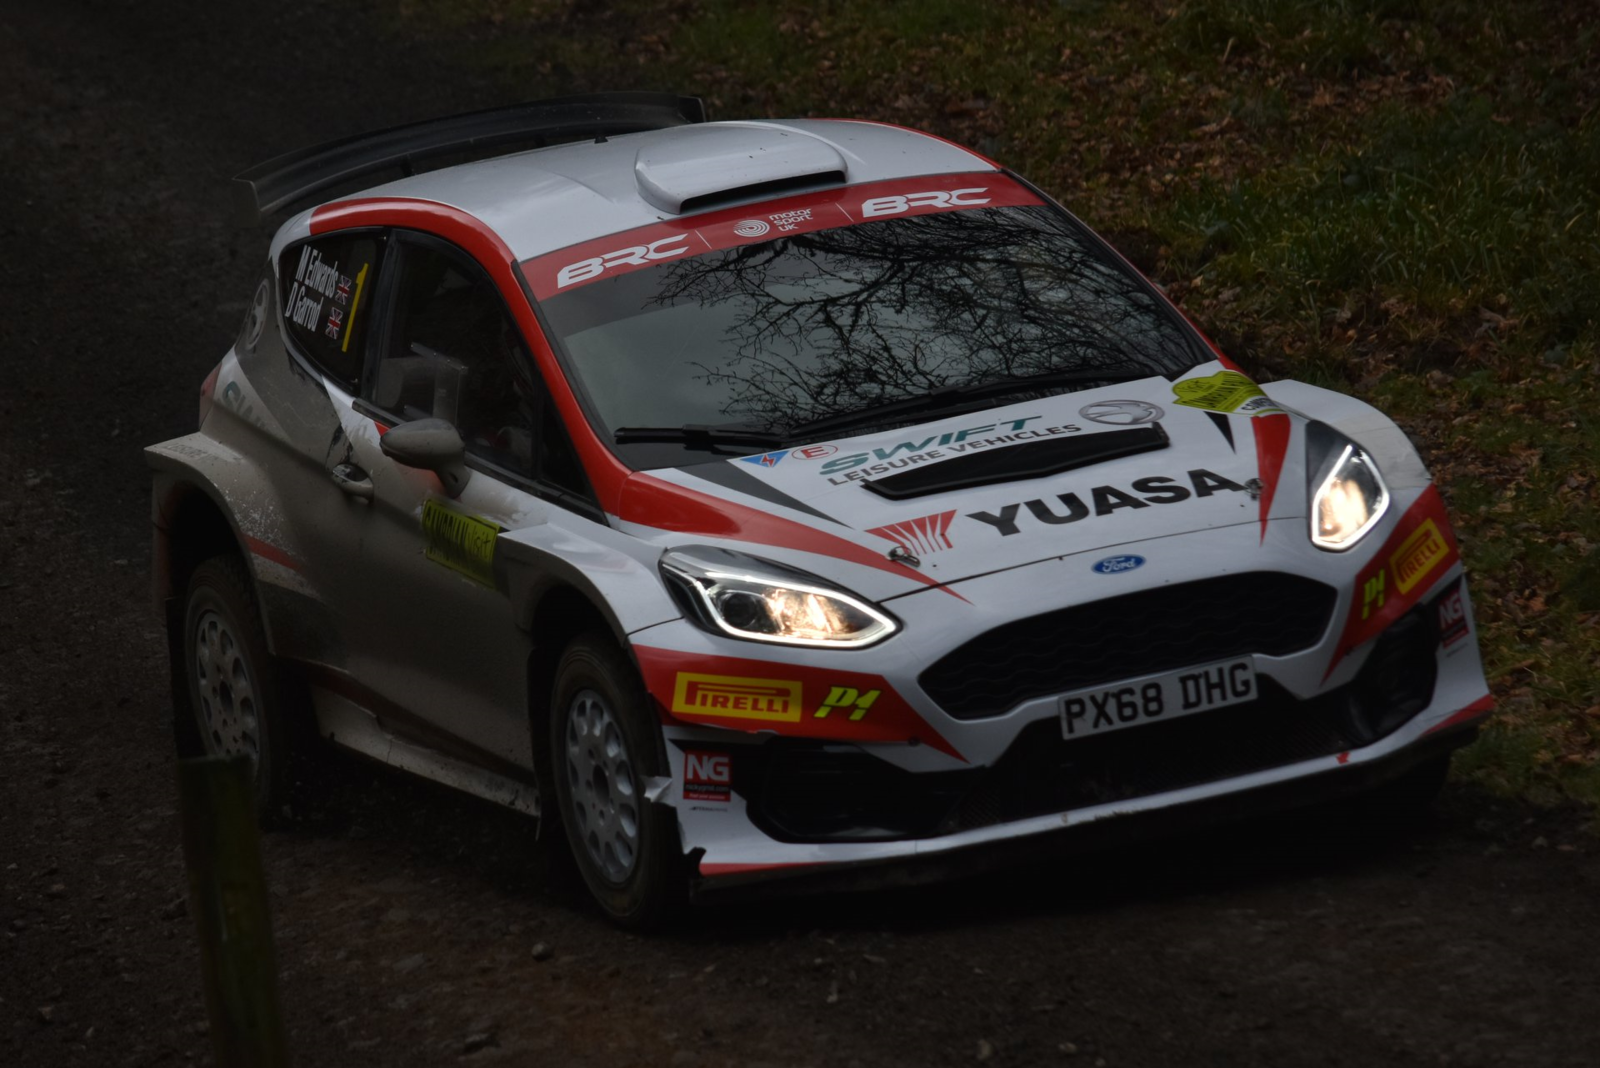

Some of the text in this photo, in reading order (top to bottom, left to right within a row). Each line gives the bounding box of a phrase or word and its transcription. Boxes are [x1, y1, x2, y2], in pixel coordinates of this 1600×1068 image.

[769, 208, 811, 221] motor
[773, 215, 814, 226] sport
[861, 187, 992, 218] BRC
[304, 248, 339, 299] Edwards
[557, 233, 689, 289] BRC
[284, 281, 324, 333] D Garrod
[819, 415, 1044, 476] SWIFT
[827, 423, 1084, 486] LEISURE VEHICLES
[965, 468, 1248, 536] YUASA
[1100, 555, 1137, 574] Ford
[1394, 529, 1441, 585] PIRELLI
[1439, 592, 1463, 631] NG
[685, 680, 792, 714] PIRELLI
[813, 685, 882, 721] P1
[1063, 661, 1252, 734] PX68 DHG
[686, 753, 730, 782] NG
